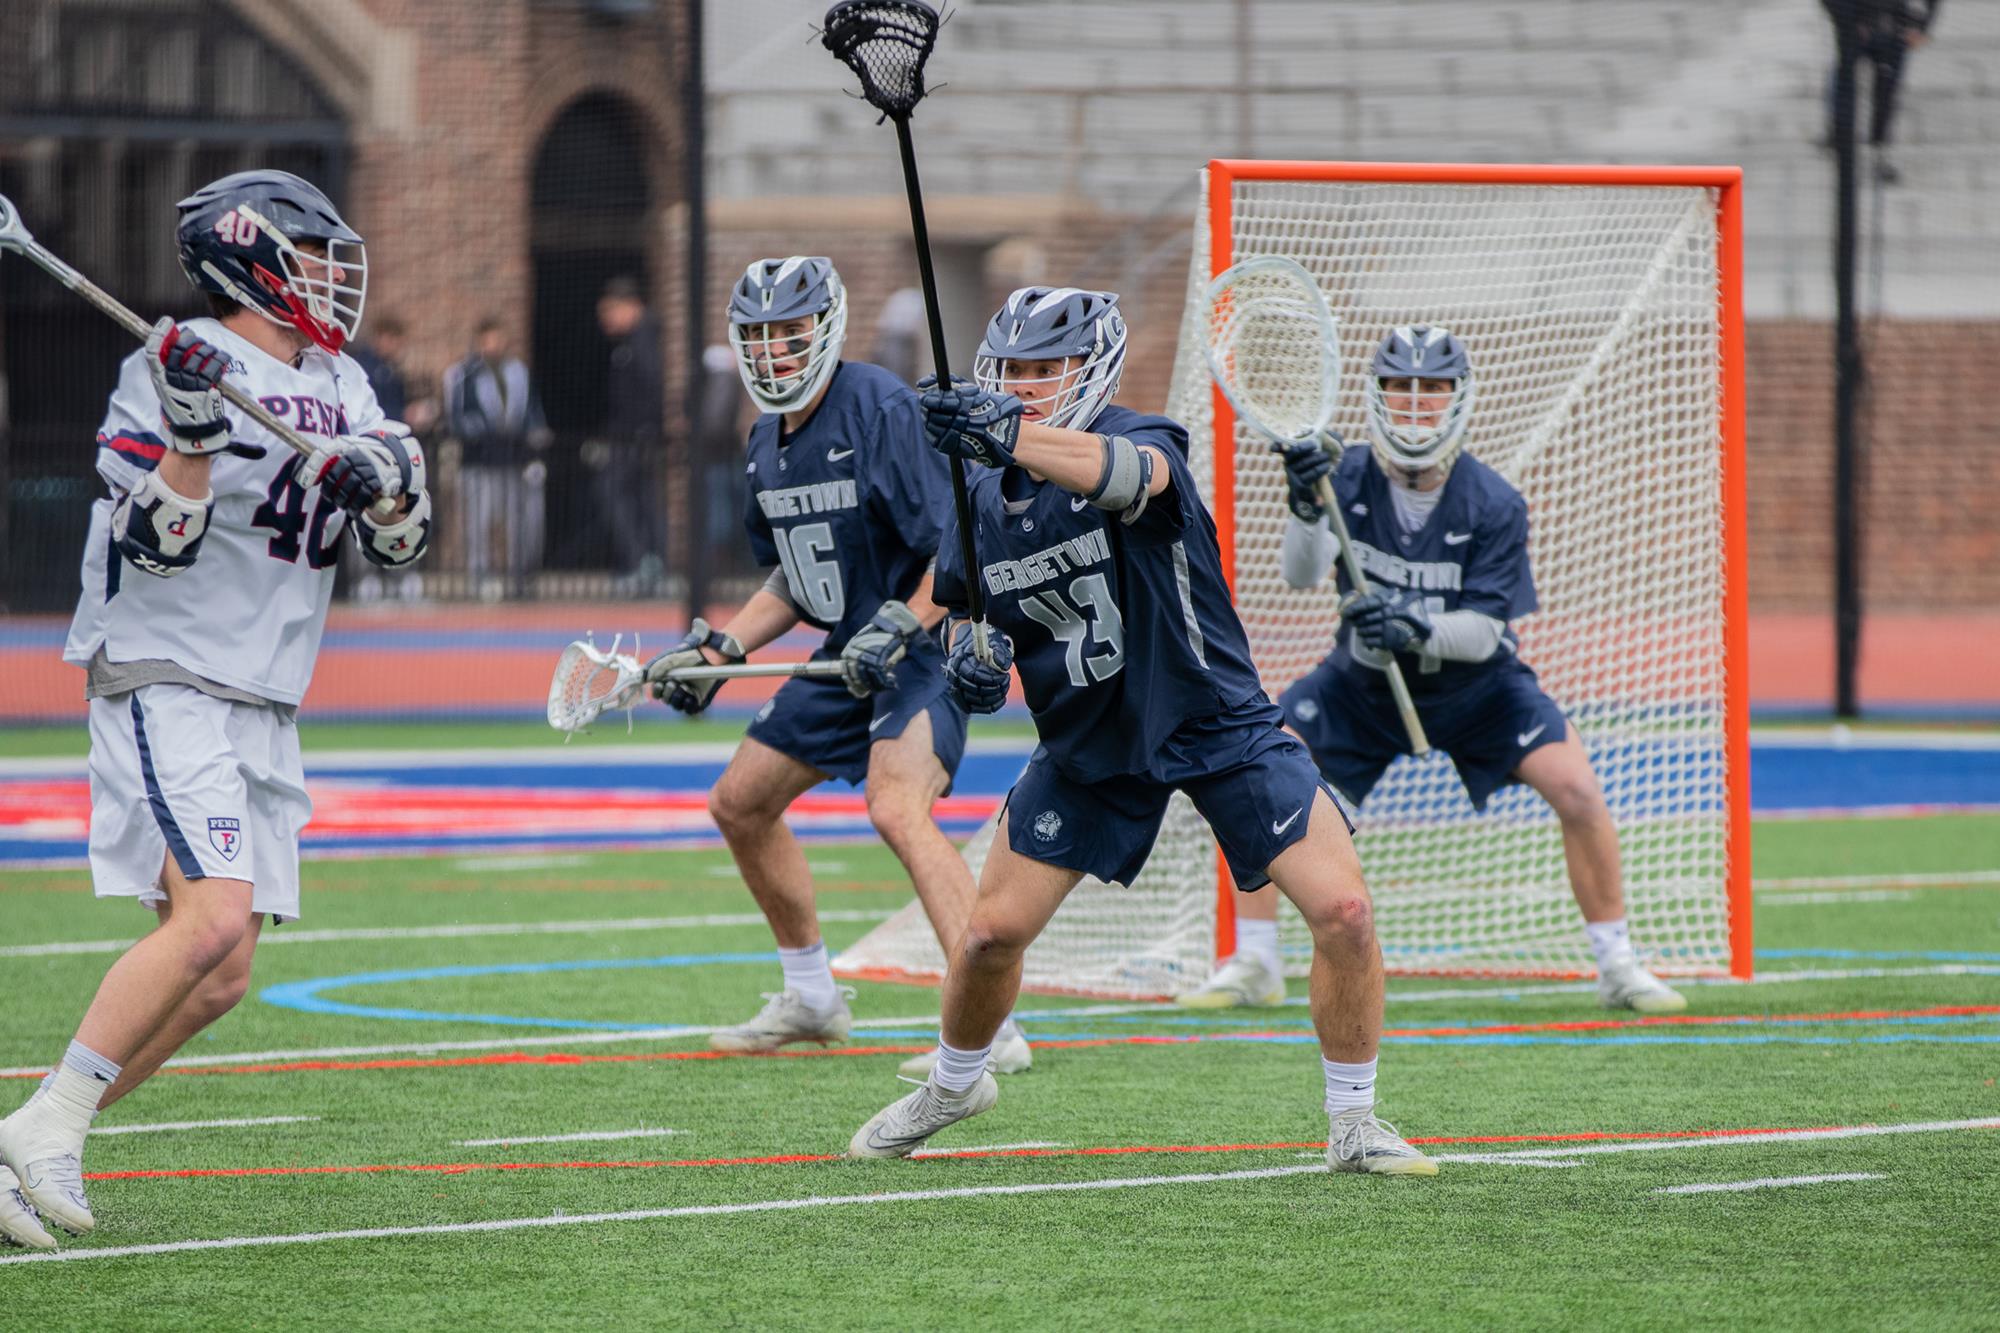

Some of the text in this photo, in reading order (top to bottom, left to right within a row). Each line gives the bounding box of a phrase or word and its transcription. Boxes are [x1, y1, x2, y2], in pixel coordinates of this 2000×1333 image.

[214, 209, 258, 247] 40
[772, 522, 845, 622] 16
[1018, 573, 1127, 687] 43
[210, 820, 238, 828] PENN
